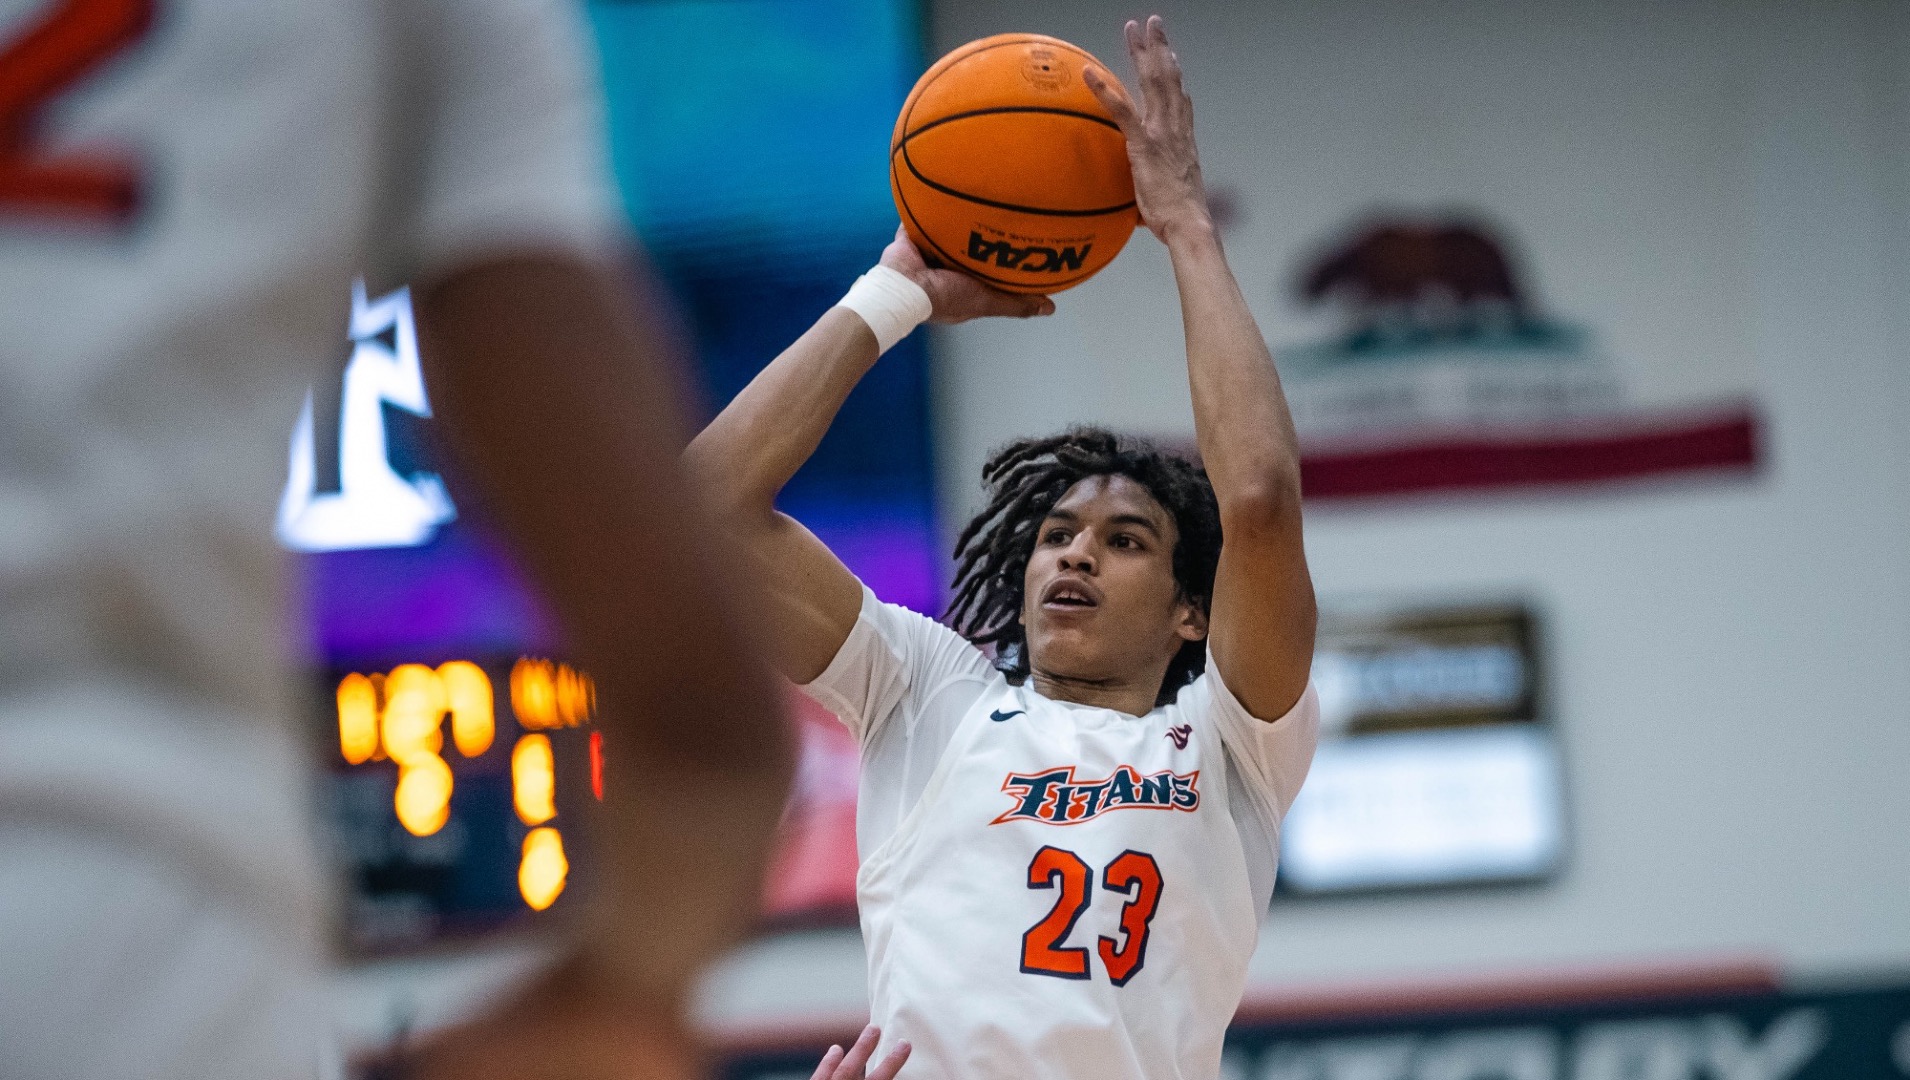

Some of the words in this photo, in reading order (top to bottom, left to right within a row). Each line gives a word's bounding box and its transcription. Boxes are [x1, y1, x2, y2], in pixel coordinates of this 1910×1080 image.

[968, 231, 1092, 272] NCAA
[1000, 766, 1199, 825] TITANS
[1020, 845, 1164, 987] 23
